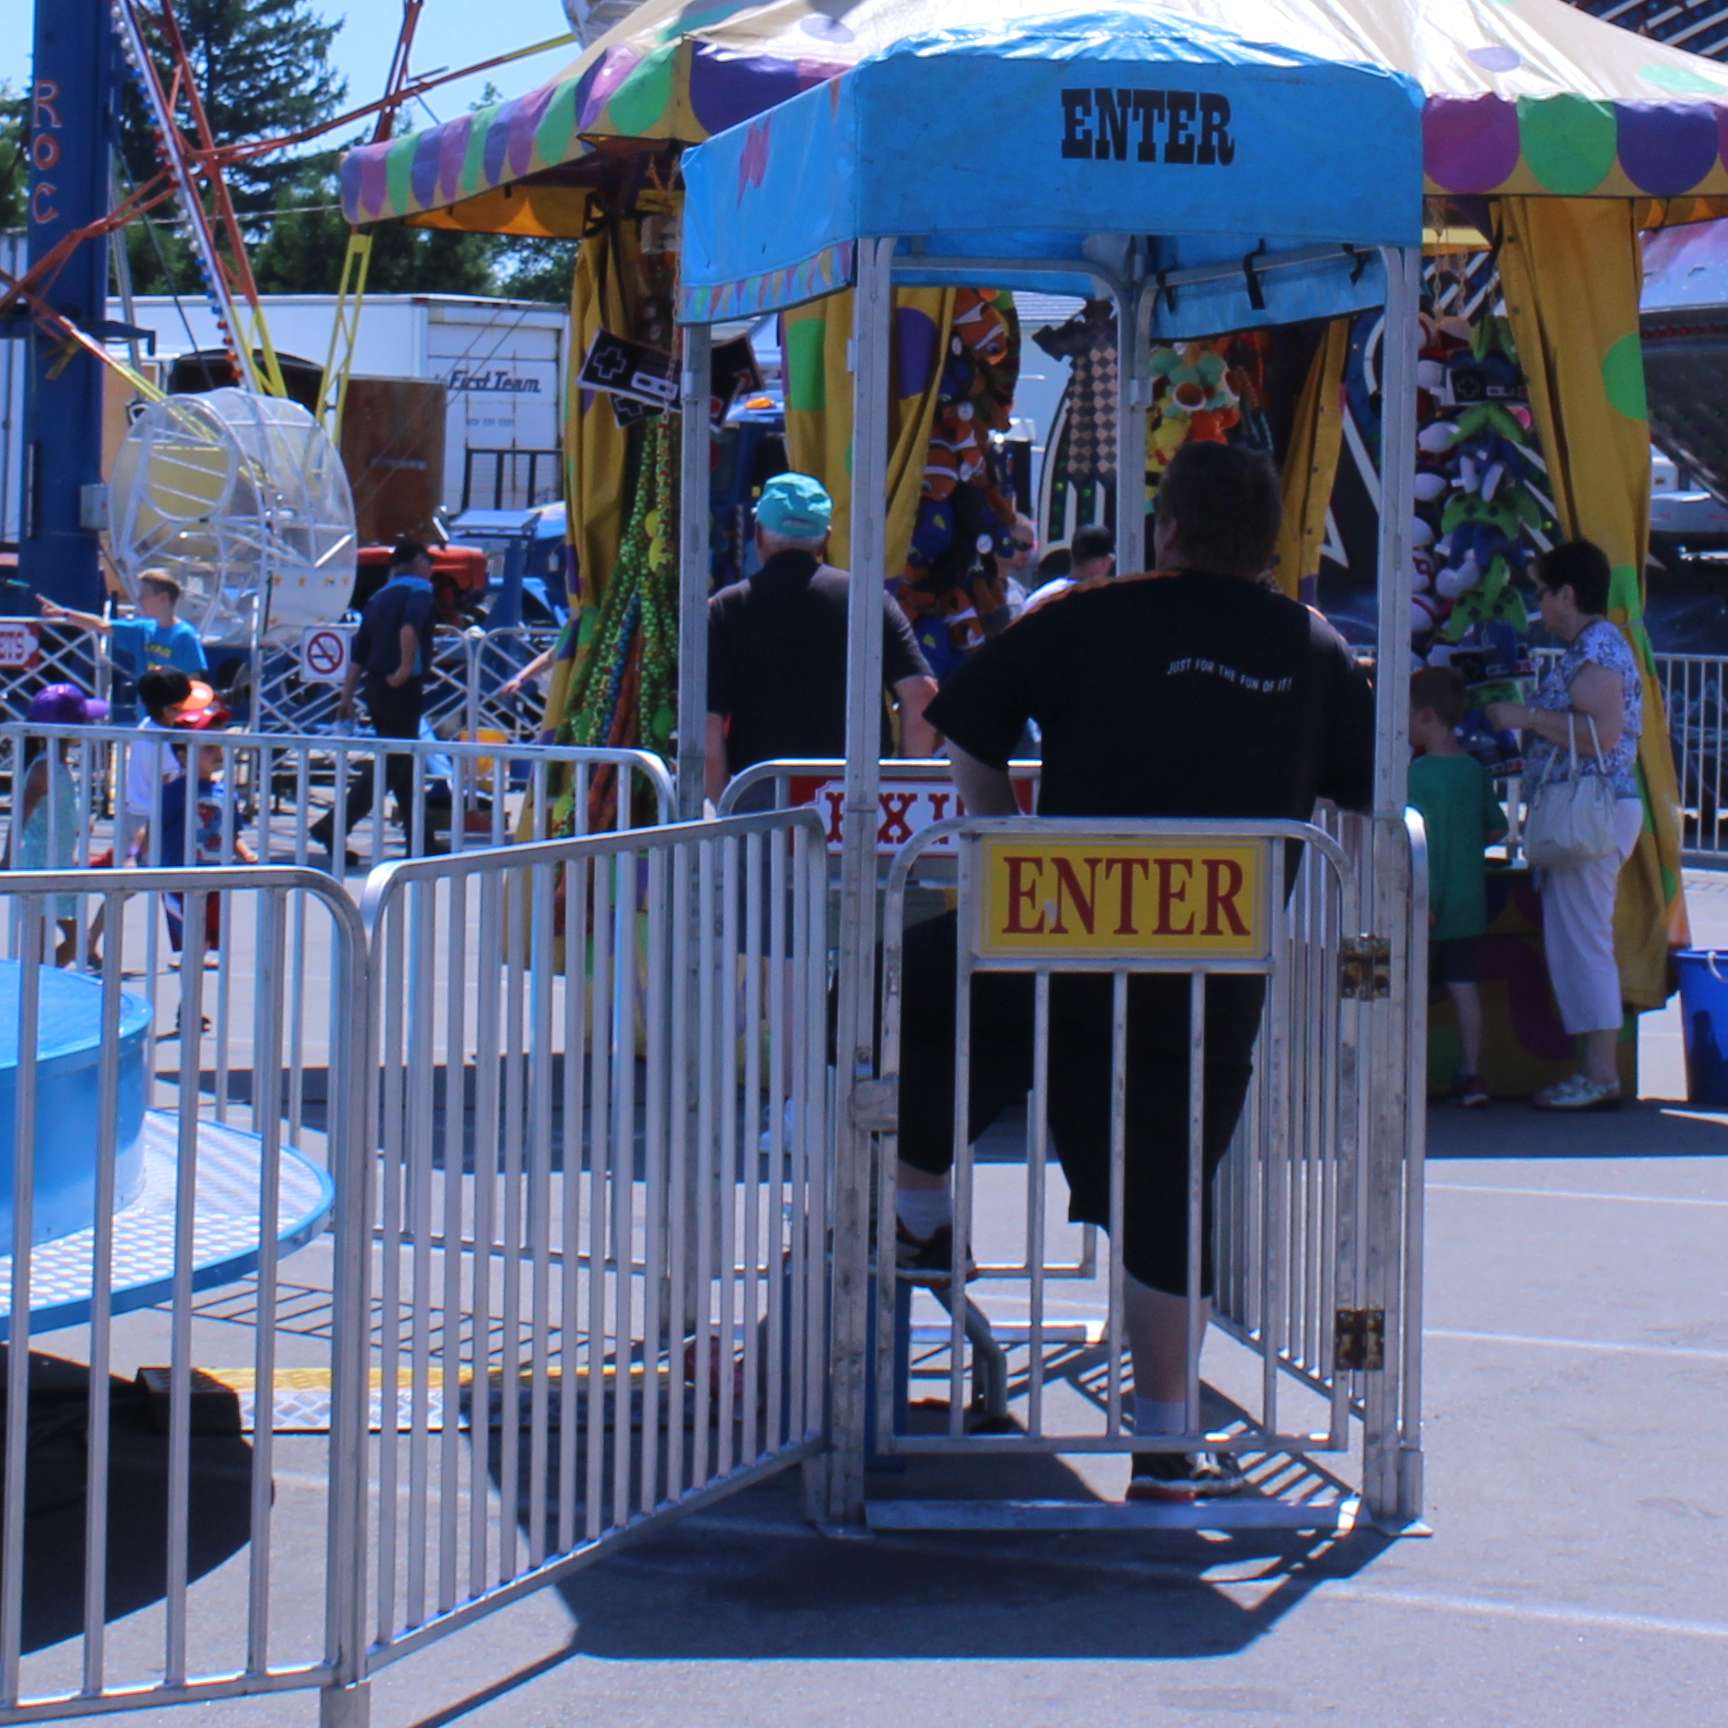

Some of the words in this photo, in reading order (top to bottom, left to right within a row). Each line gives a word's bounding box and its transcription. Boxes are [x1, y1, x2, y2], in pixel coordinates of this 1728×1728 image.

[1060, 88, 1235, 166] ENTER
[1167, 657, 1192, 675] JUST
[1195, 657, 1216, 672] FOR
[1219, 664, 1236, 682] THE
[1239, 674, 1259, 690] FUN
[1001, 856, 1251, 936] ENTER
